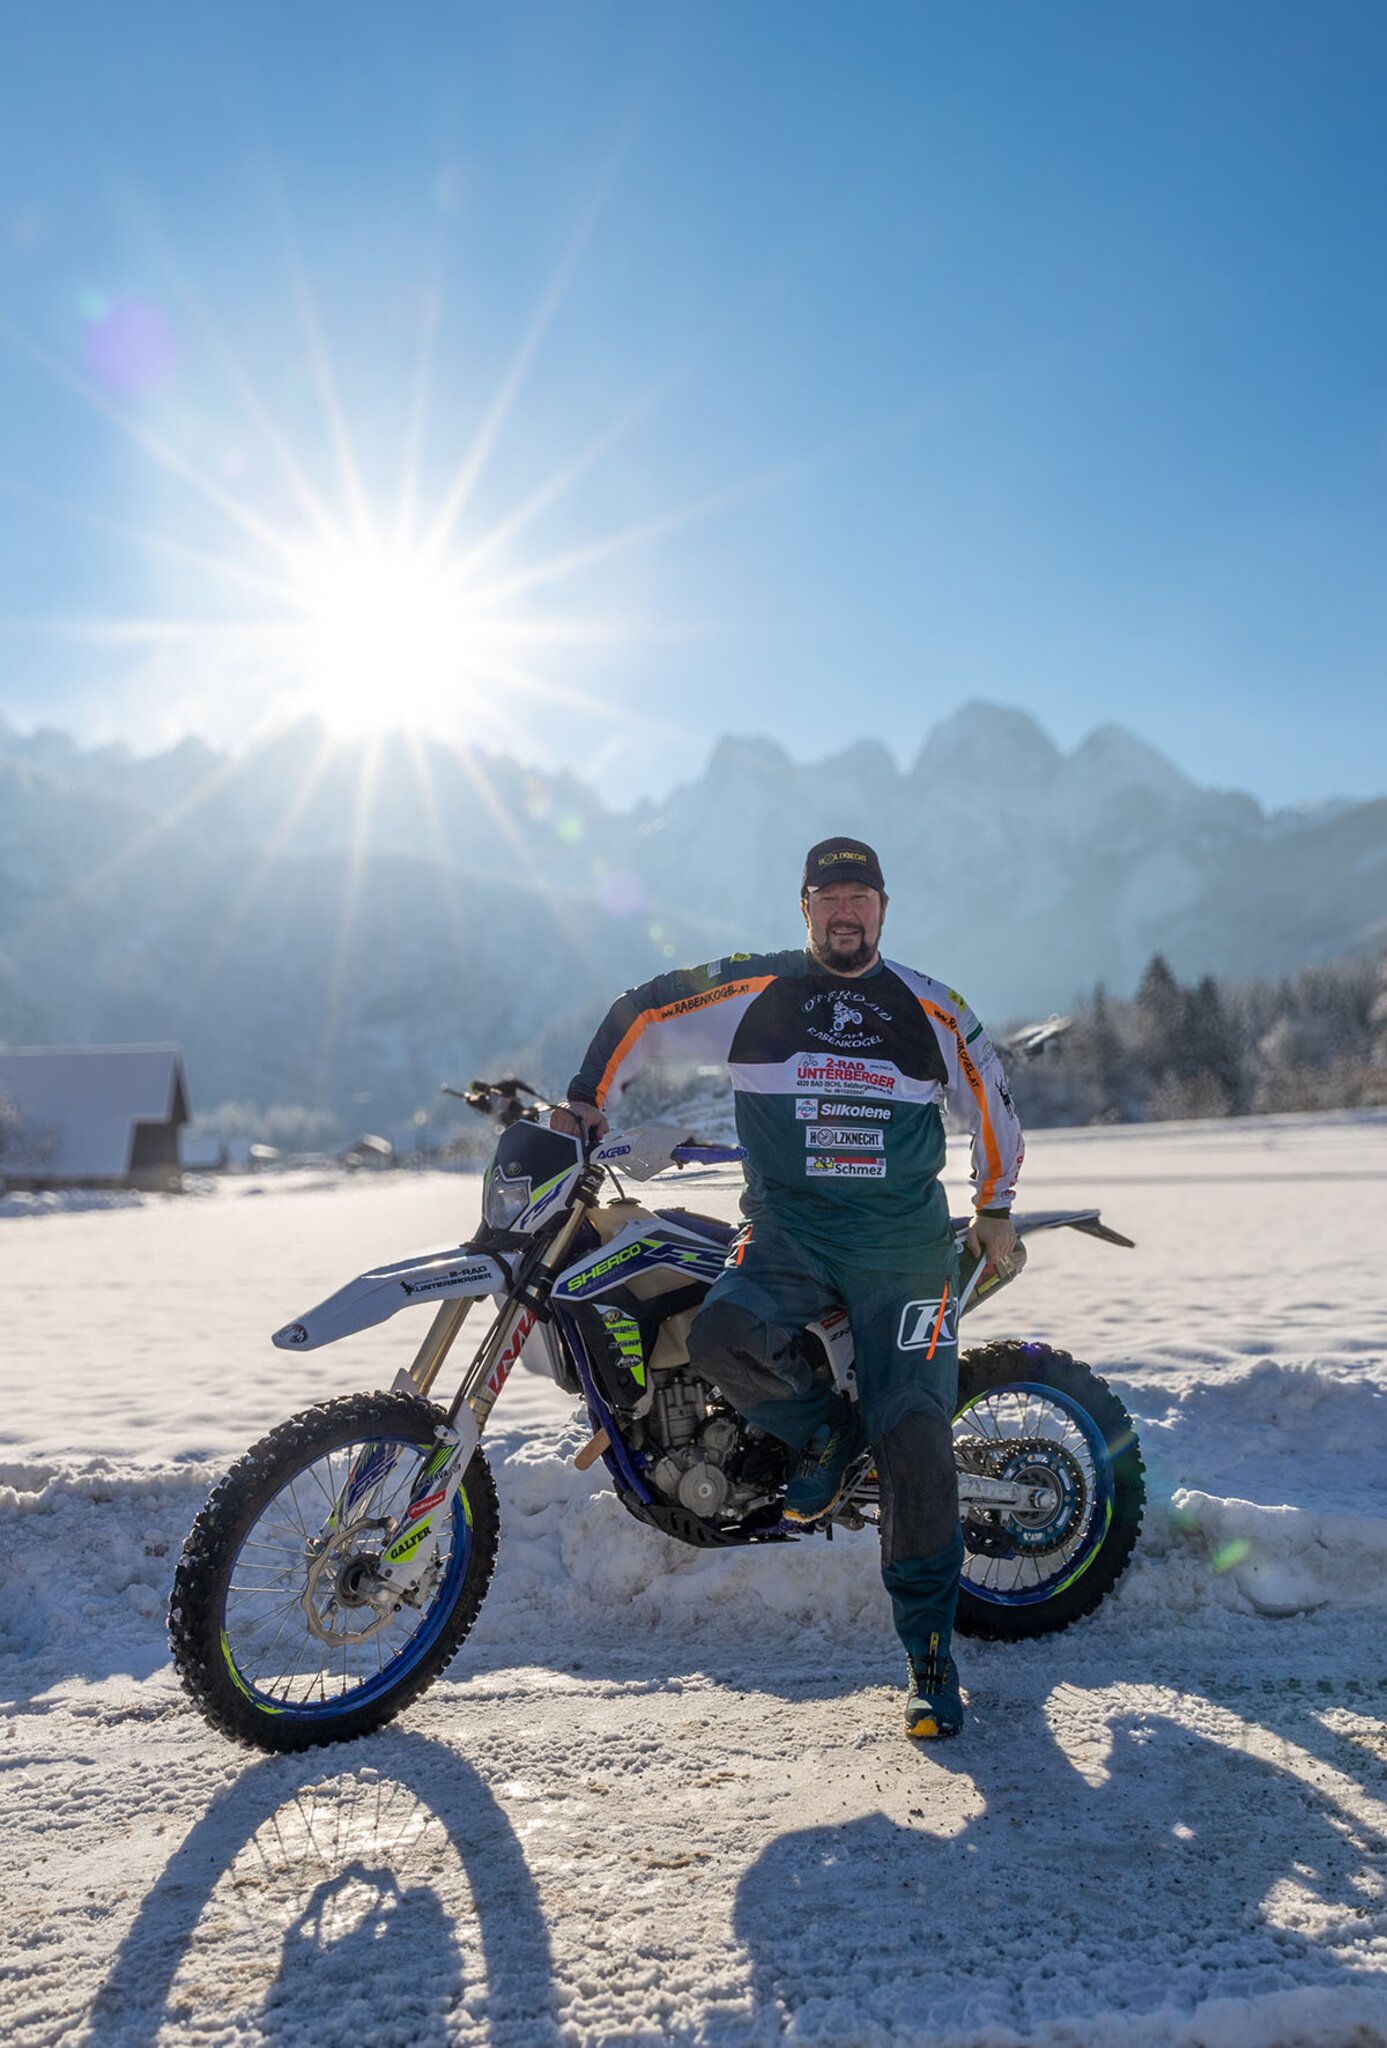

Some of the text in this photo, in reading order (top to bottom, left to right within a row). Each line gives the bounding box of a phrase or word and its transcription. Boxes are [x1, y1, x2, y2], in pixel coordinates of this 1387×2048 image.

[807, 1027, 884, 1048] RABENKOGEL
[826, 1057, 865, 1071] 2-RAD
[797, 1067, 896, 1090] UNTERBERGER
[820, 1103, 892, 1119] Silkolene
[567, 1243, 642, 1293] SHERCO
[390, 1526, 432, 1560] GALFER
